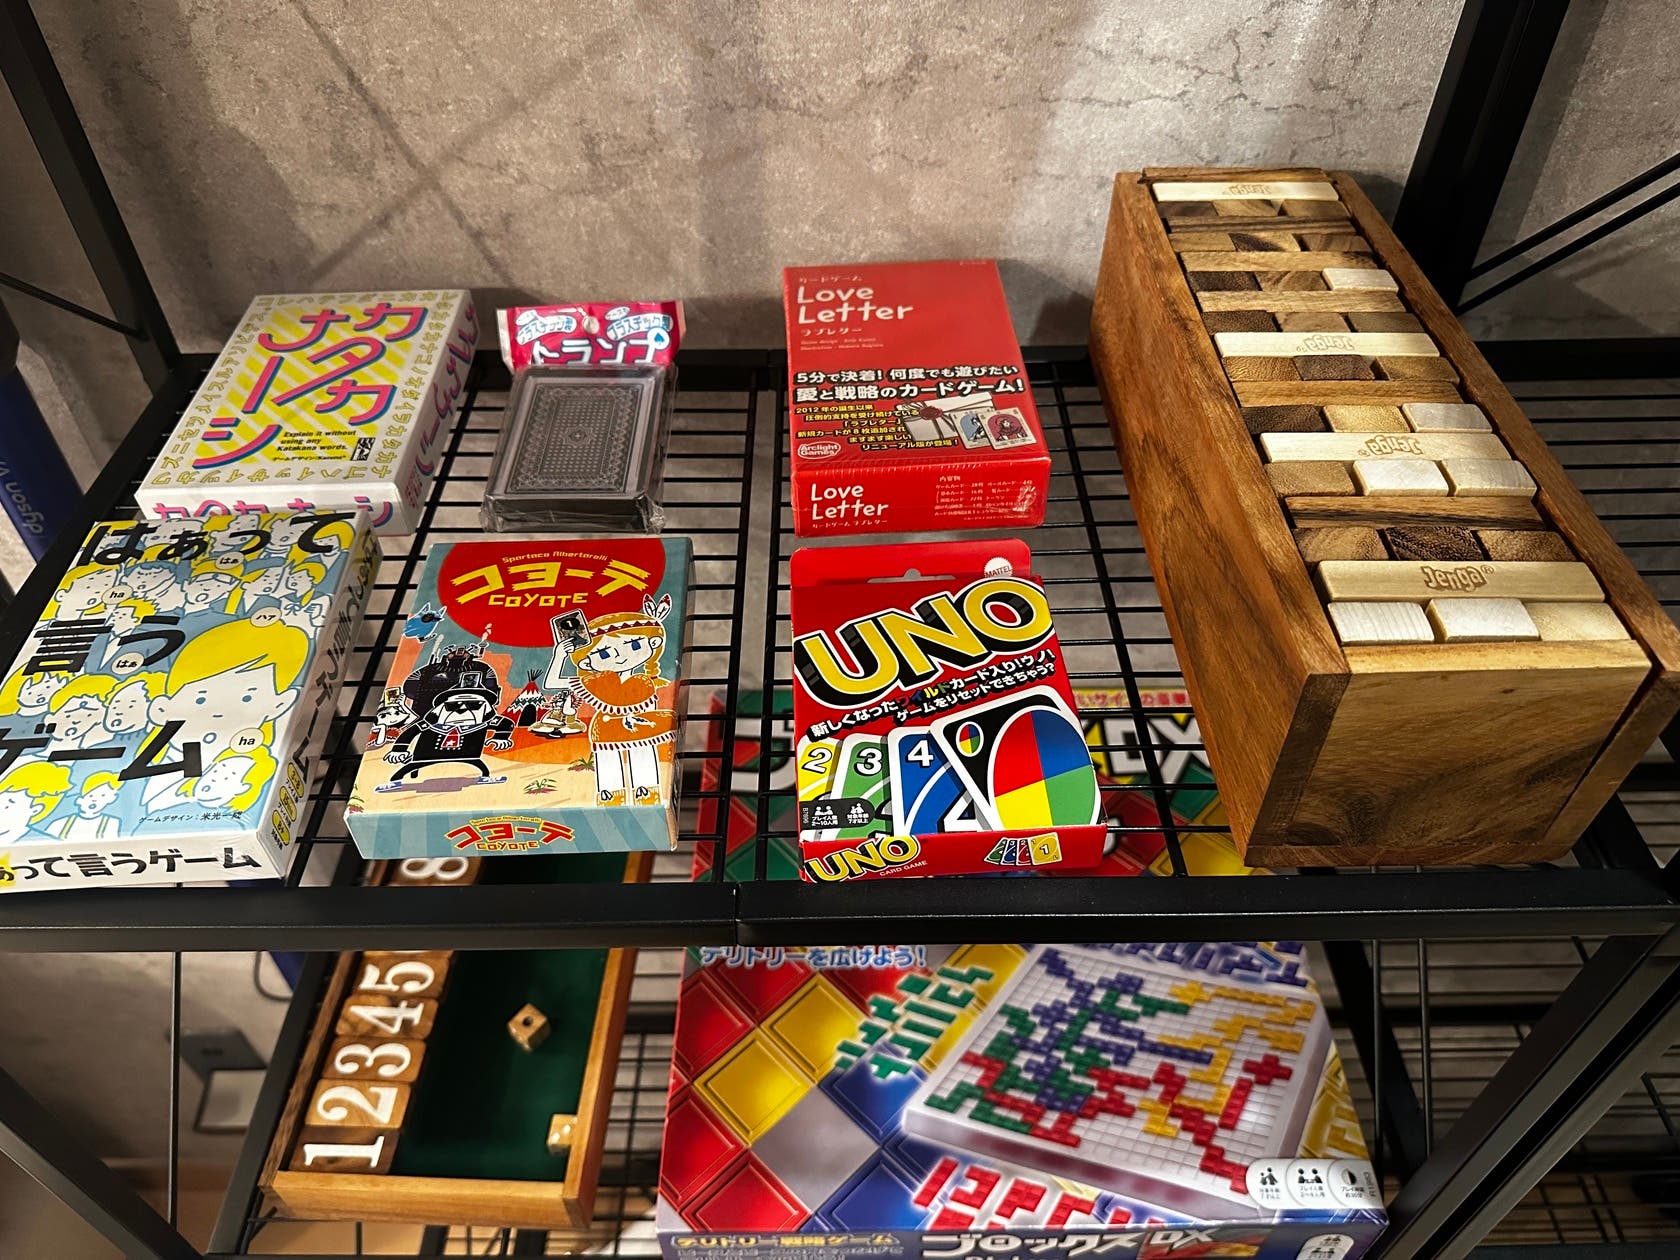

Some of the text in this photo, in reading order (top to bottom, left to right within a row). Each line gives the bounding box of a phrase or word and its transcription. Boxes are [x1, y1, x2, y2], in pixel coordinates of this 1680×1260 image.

[797, 286, 874, 304] Love
[798, 301, 914, 324] Letter
[1307, 334, 1355, 353] Jenga
[796, 365, 1019, 384] 5分で決着! 何度でも遊びたい
[796, 378, 1025, 403] 愛と戦略のカードゲーム!
[1367, 435, 1423, 456] Jenga
[811, 483, 865, 501] Love
[812, 499, 889, 520] Letter
[75, 512, 357, 567] はぁって
[219, 556, 241, 567] はぁ
[502, 552, 550, 563] Spartaco
[451, 559, 652, 605] コヨーテ
[1421, 566, 1488, 592] Jenga
[487, 592, 589, 608] COYOTE
[22, 615, 187, 678] 言う
[797, 576, 1051, 700] UNO
[116, 658, 138, 669] はぁ
[896, 662, 1056, 722] ゲームをリセットできちゃう?
[237, 735, 255, 746] ha
[907, 739, 934, 767] 4
[802, 748, 833, 774] 2
[855, 748, 883, 775] 3
[445, 820, 575, 849] コヨーテ
[476, 841, 539, 850] COYOTE
[400, 856, 469, 881] 8
[804, 834, 919, 882] UNO
[879, 860, 927, 877] CARD GAME
[359, 961, 435, 994] 5
[349, 1000, 425, 1035] 4
[335, 1042, 412, 1077] 3
[316, 1085, 398, 1124] 2
[303, 1135, 385, 1169] 1
[922, 1233, 1143, 1257] ブロックス
[1147, 1230, 1214, 1248] DX
